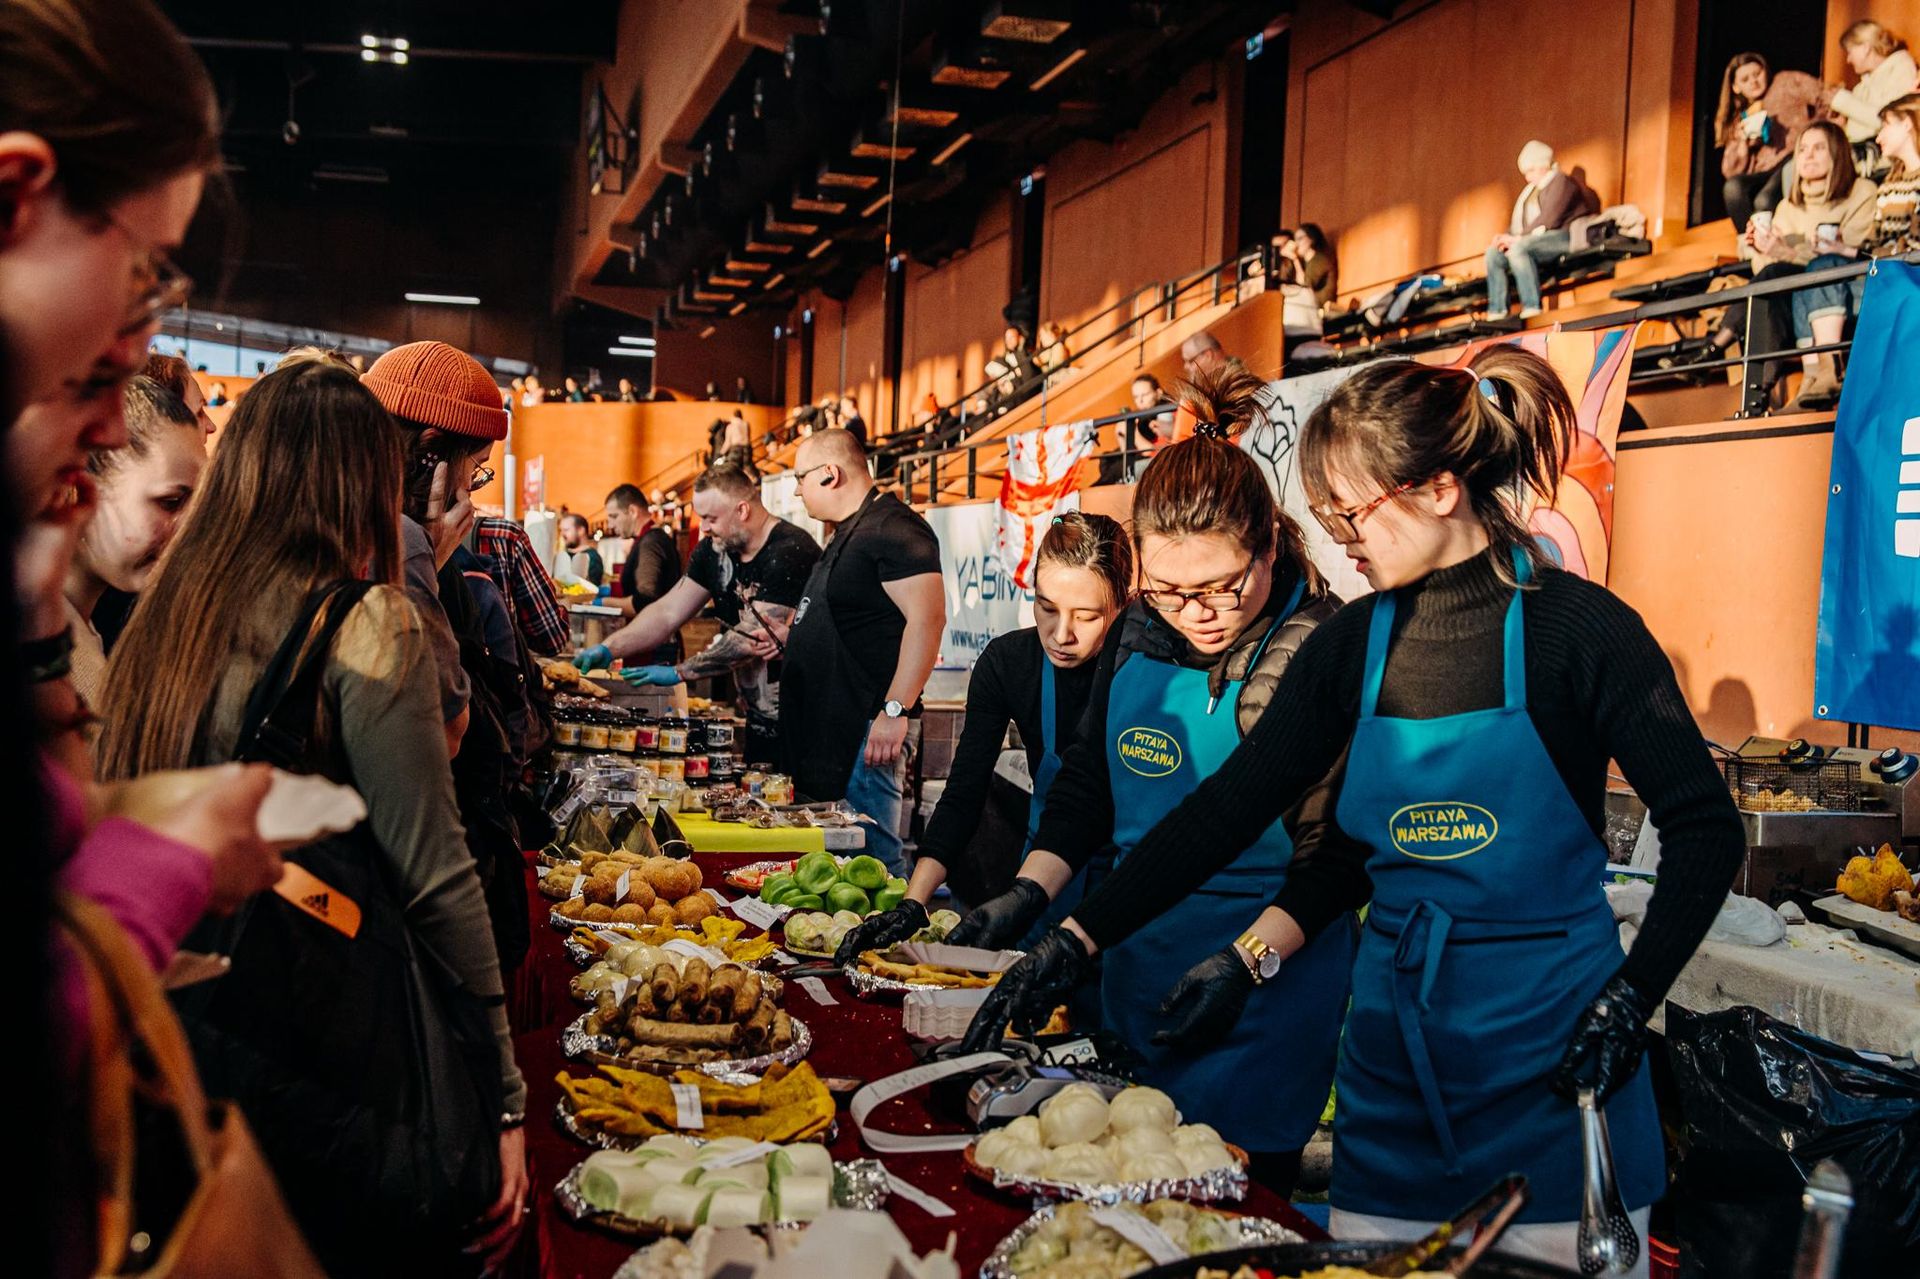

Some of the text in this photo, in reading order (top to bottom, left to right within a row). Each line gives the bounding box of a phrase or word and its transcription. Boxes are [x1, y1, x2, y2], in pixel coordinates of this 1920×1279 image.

[1134, 732, 1167, 750] PITAYA
[1122, 743, 1174, 768] WARSZAWA
[1409, 808, 1468, 824] PITAYA
[1396, 823, 1488, 843] WARSZAWA
